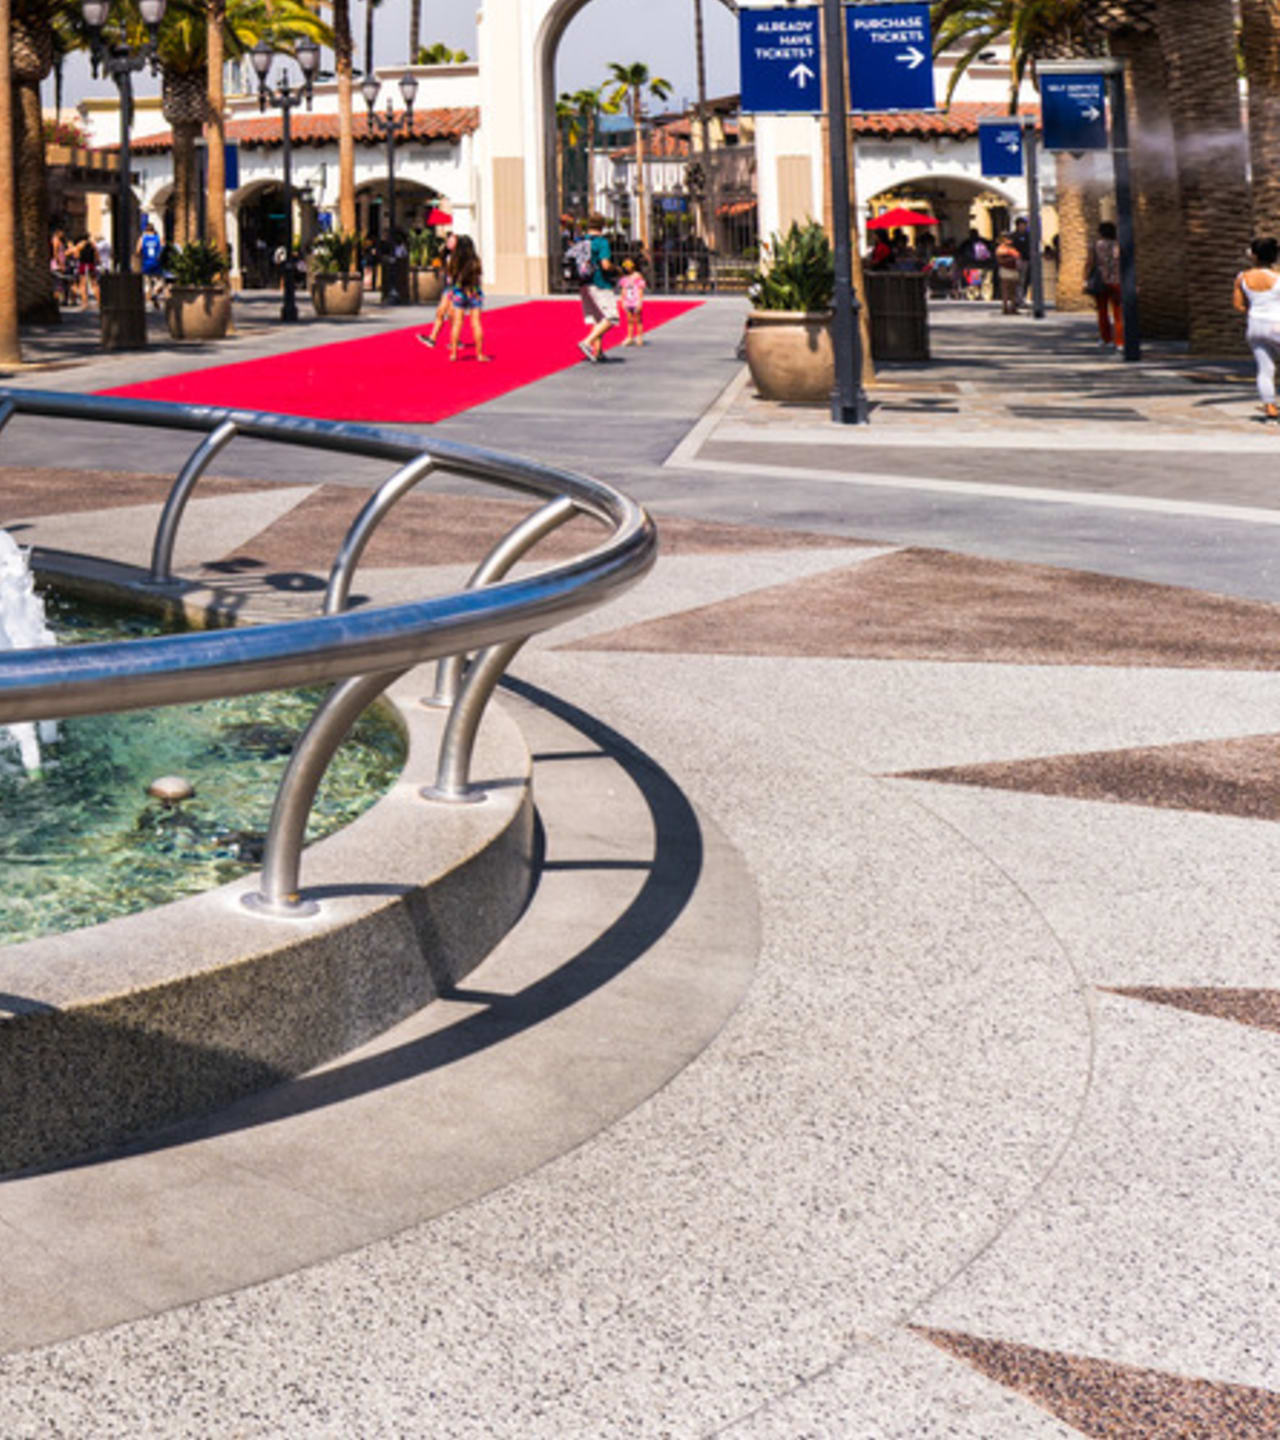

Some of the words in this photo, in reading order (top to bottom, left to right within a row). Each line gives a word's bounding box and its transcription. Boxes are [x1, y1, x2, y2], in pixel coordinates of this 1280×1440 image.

[755, 21, 813, 32] ALREADY
[854, 16, 923, 29] PURCHASE
[779, 35, 813, 46] HAVE
[871, 31, 925, 43] TICKETS
[755, 48, 814, 59] TICKETS?
